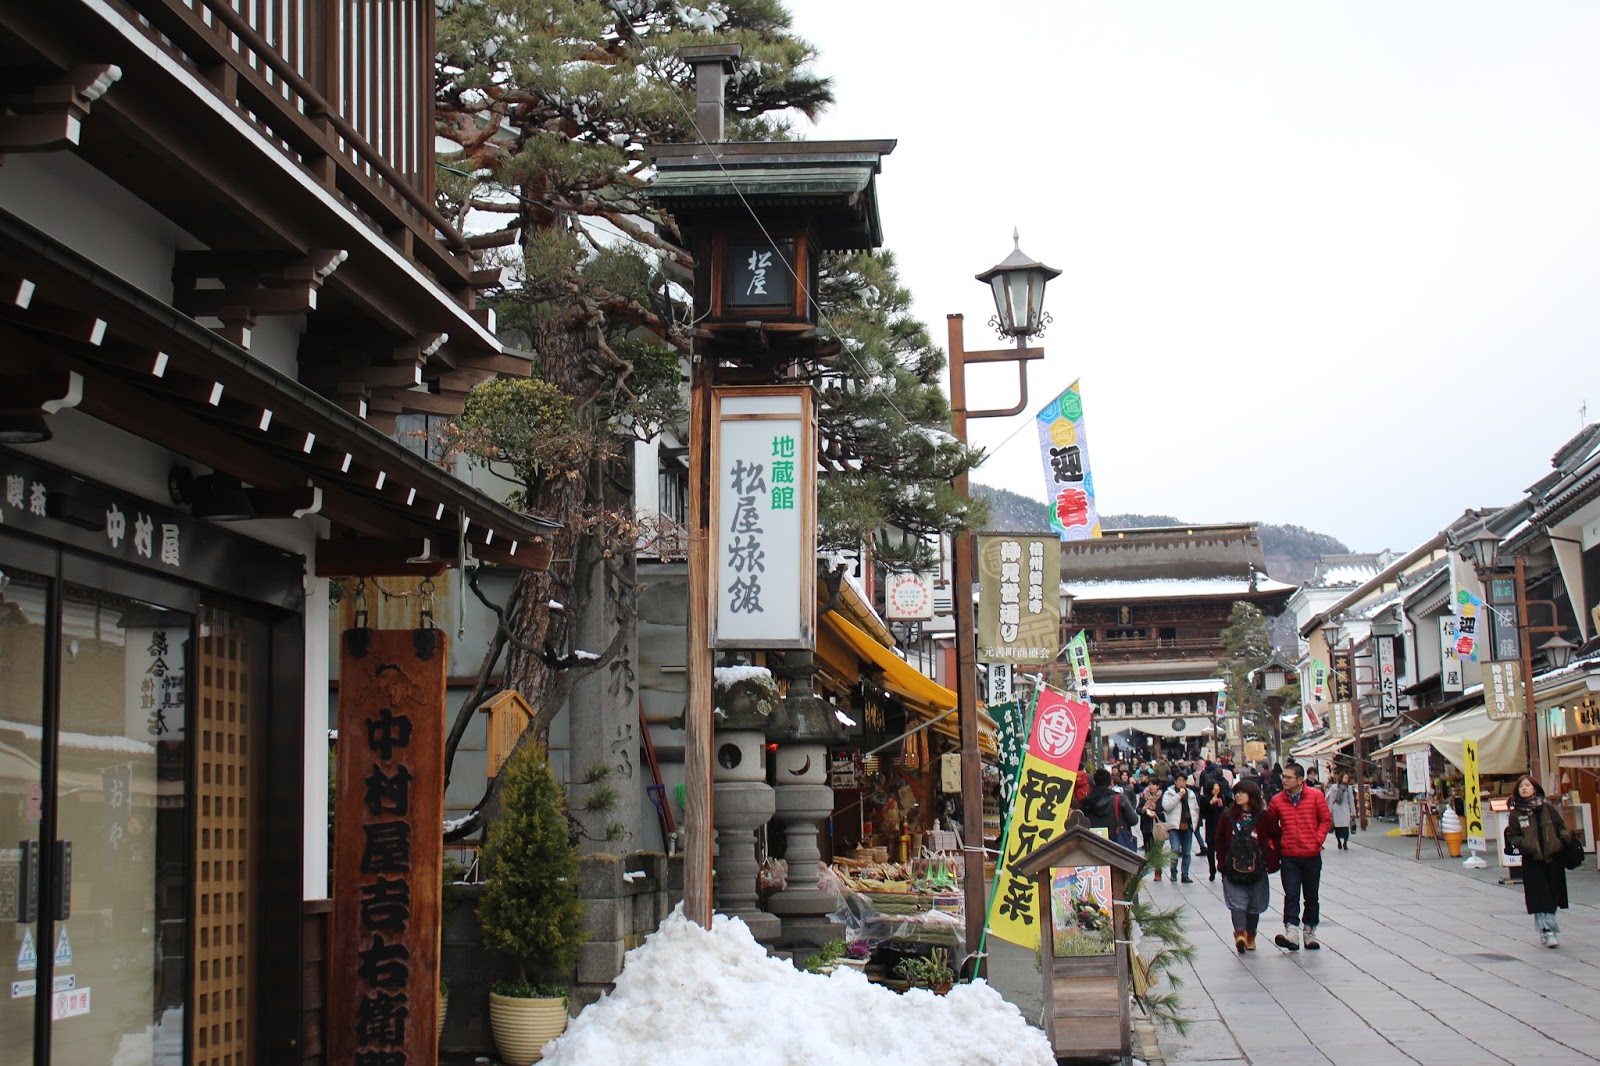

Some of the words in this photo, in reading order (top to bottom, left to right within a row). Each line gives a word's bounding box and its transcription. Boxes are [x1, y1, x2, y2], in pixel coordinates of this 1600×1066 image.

[747, 249, 773, 296] 松屋
[6, 474, 47, 517] 喫茶
[771, 435, 795, 510] 地蔵館
[1050, 445, 1088, 527] 迎春
[106, 503, 180, 567] 中村屋
[984, 646, 1051, 659] 元善町商盛会
[1456, 616, 1476, 655] 迎春
[1497, 609, 1517, 657] 佐藤
[1384, 677, 1395, 714] たきや
